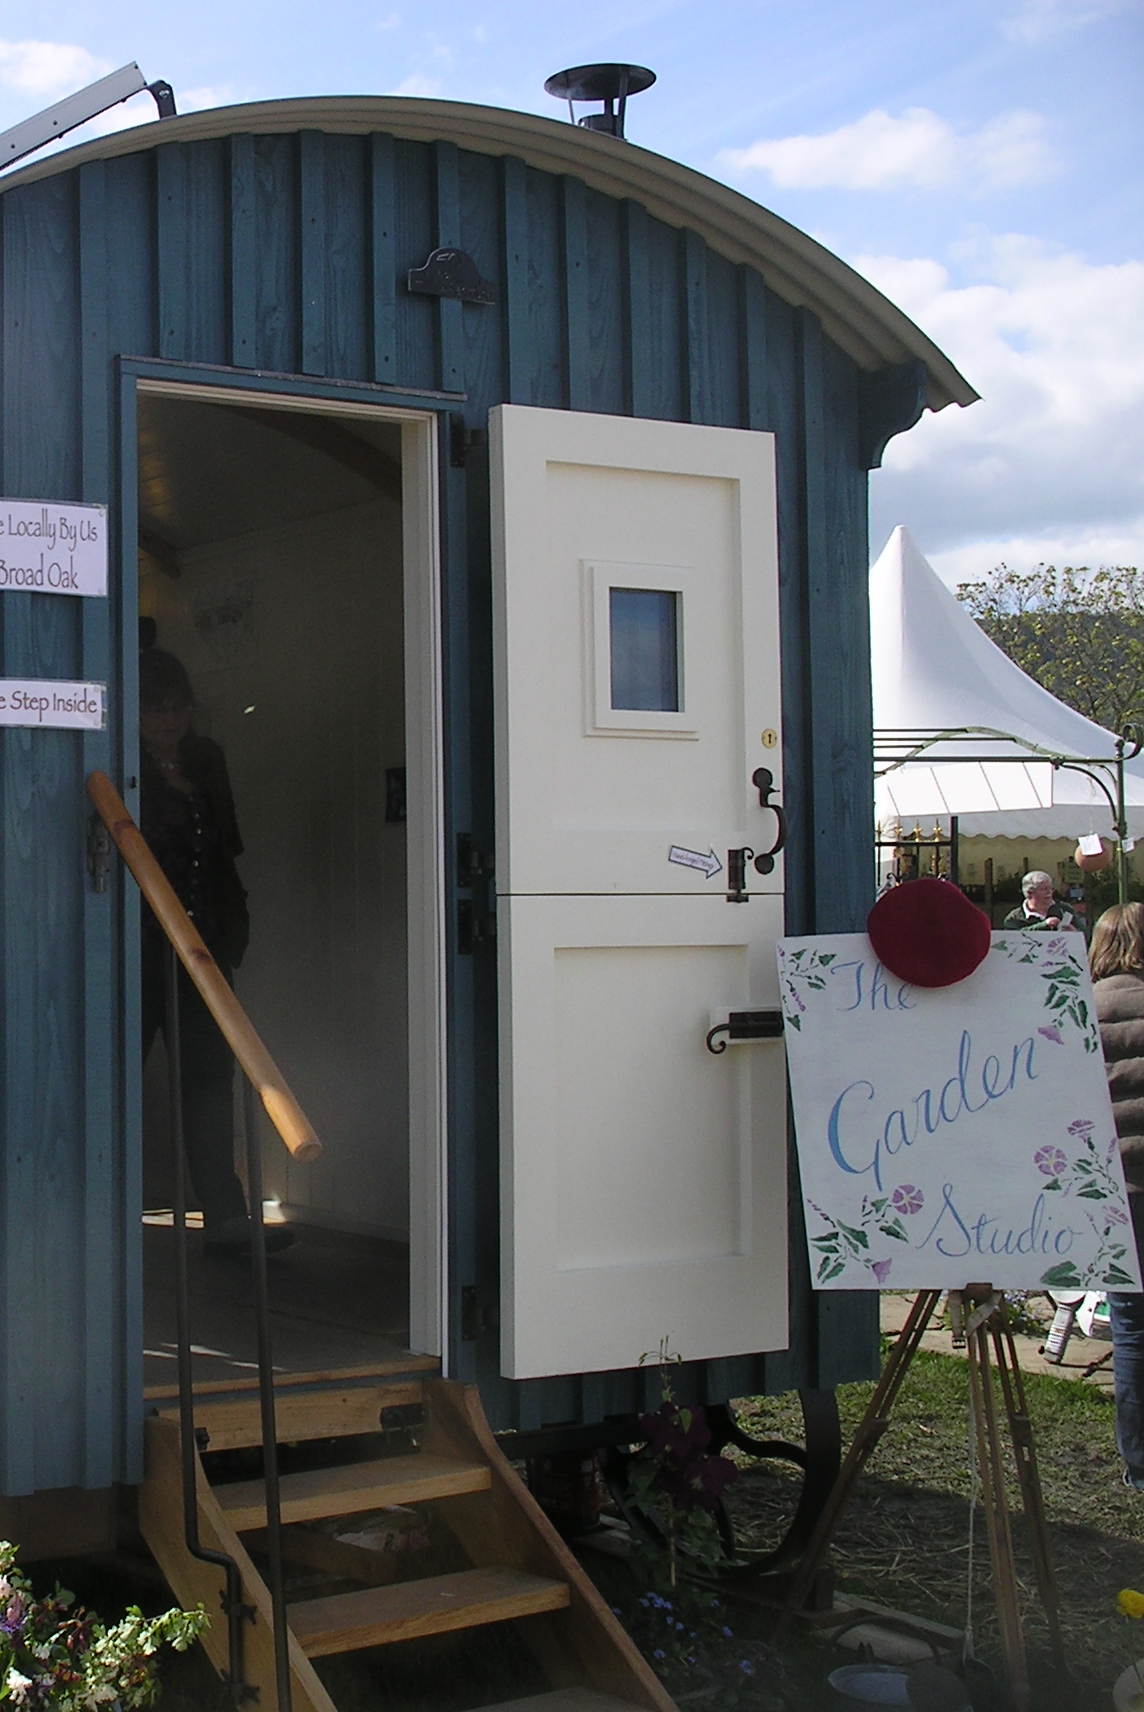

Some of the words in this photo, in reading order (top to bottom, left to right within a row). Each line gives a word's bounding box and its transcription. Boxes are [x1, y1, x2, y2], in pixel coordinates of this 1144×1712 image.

[8, 508, 57, 551] Locally
[59, 517, 78, 552] By
[80, 520, 98, 542] Us
[47, 555, 79, 589] Oak
[10, 690, 50, 723] Step
[52, 688, 98, 714] Inside
[830, 959, 917, 1012] The
[827, 1029, 1039, 1192] Garden
[914, 1182, 1084, 1257] Studio
